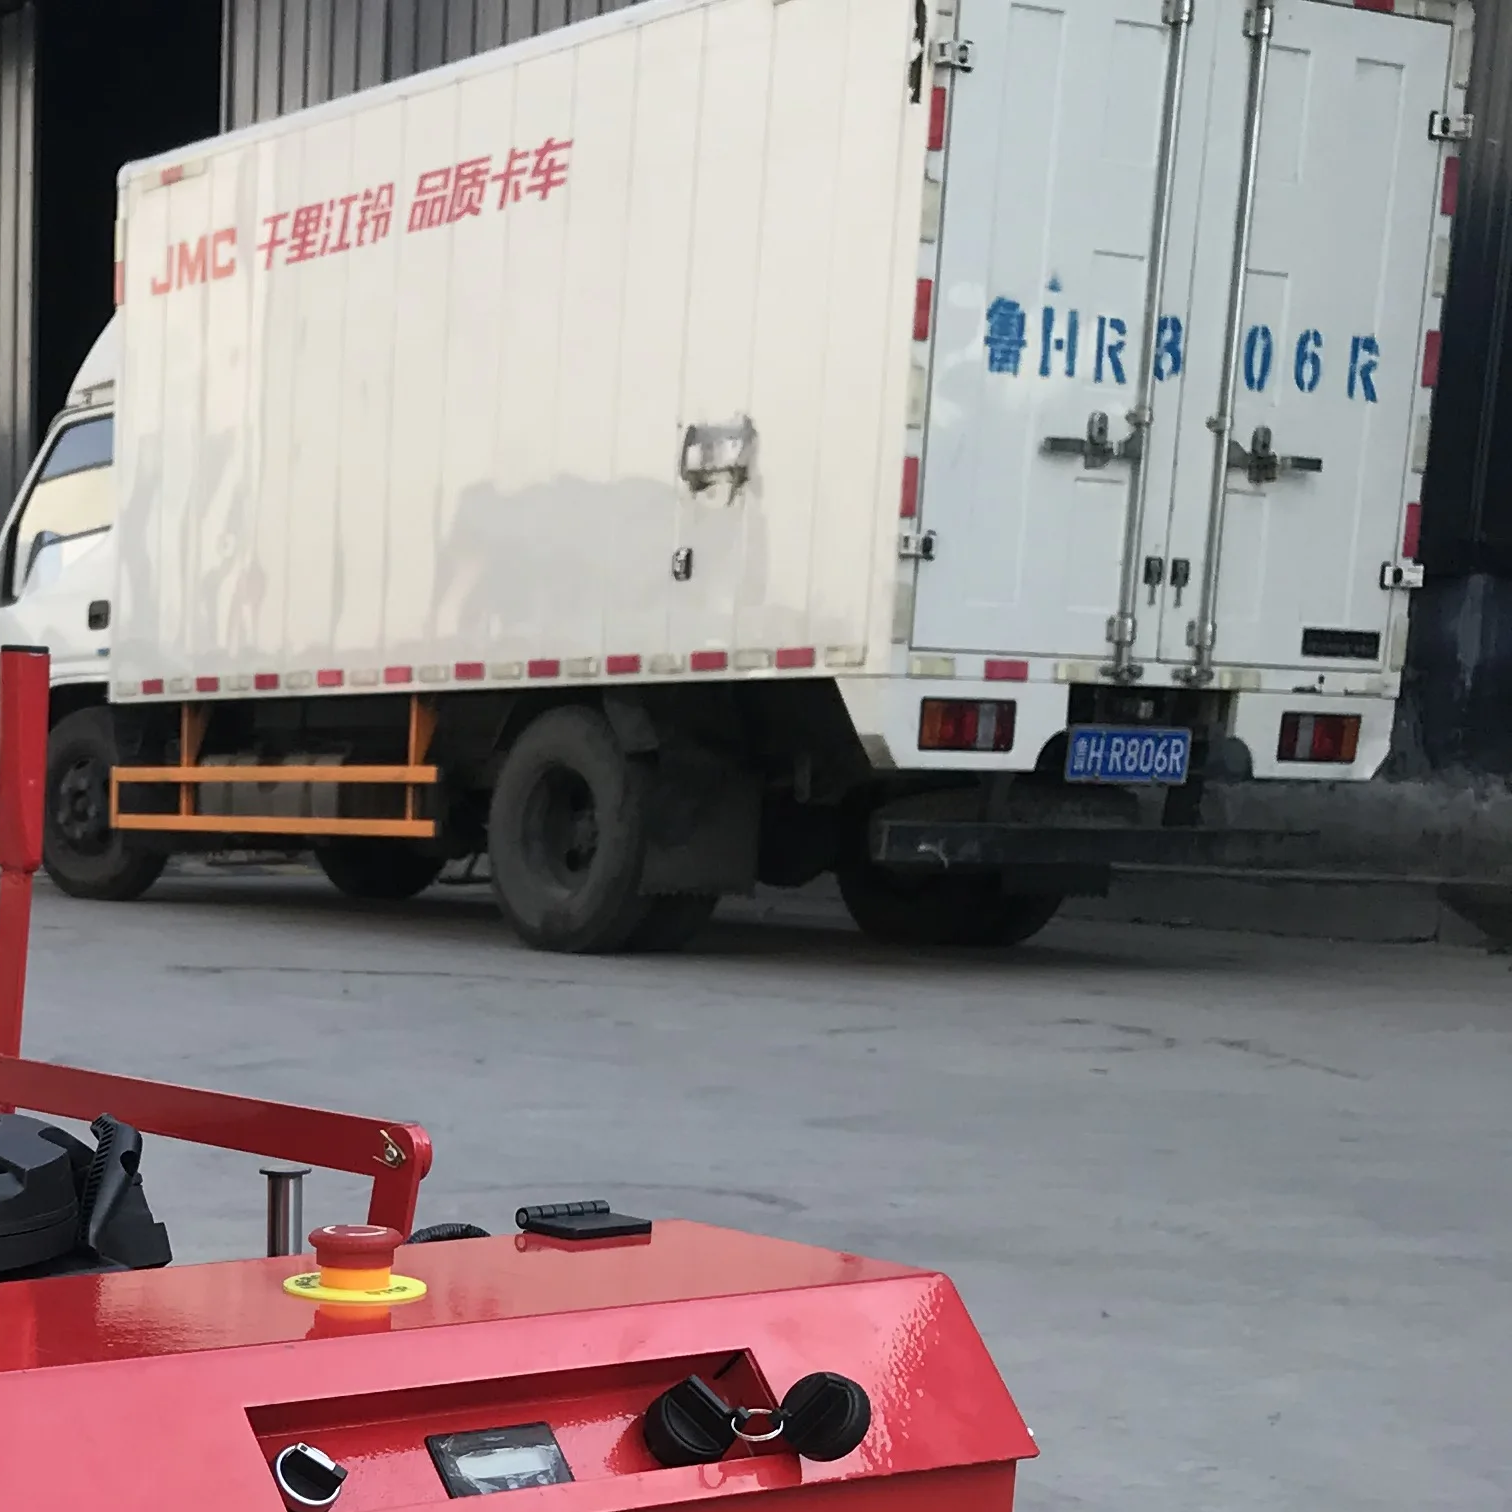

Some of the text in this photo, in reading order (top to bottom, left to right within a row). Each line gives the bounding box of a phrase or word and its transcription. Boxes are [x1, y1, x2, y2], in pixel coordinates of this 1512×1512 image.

[150, 137, 574, 296] JMC 千里江铃 品质卡车
